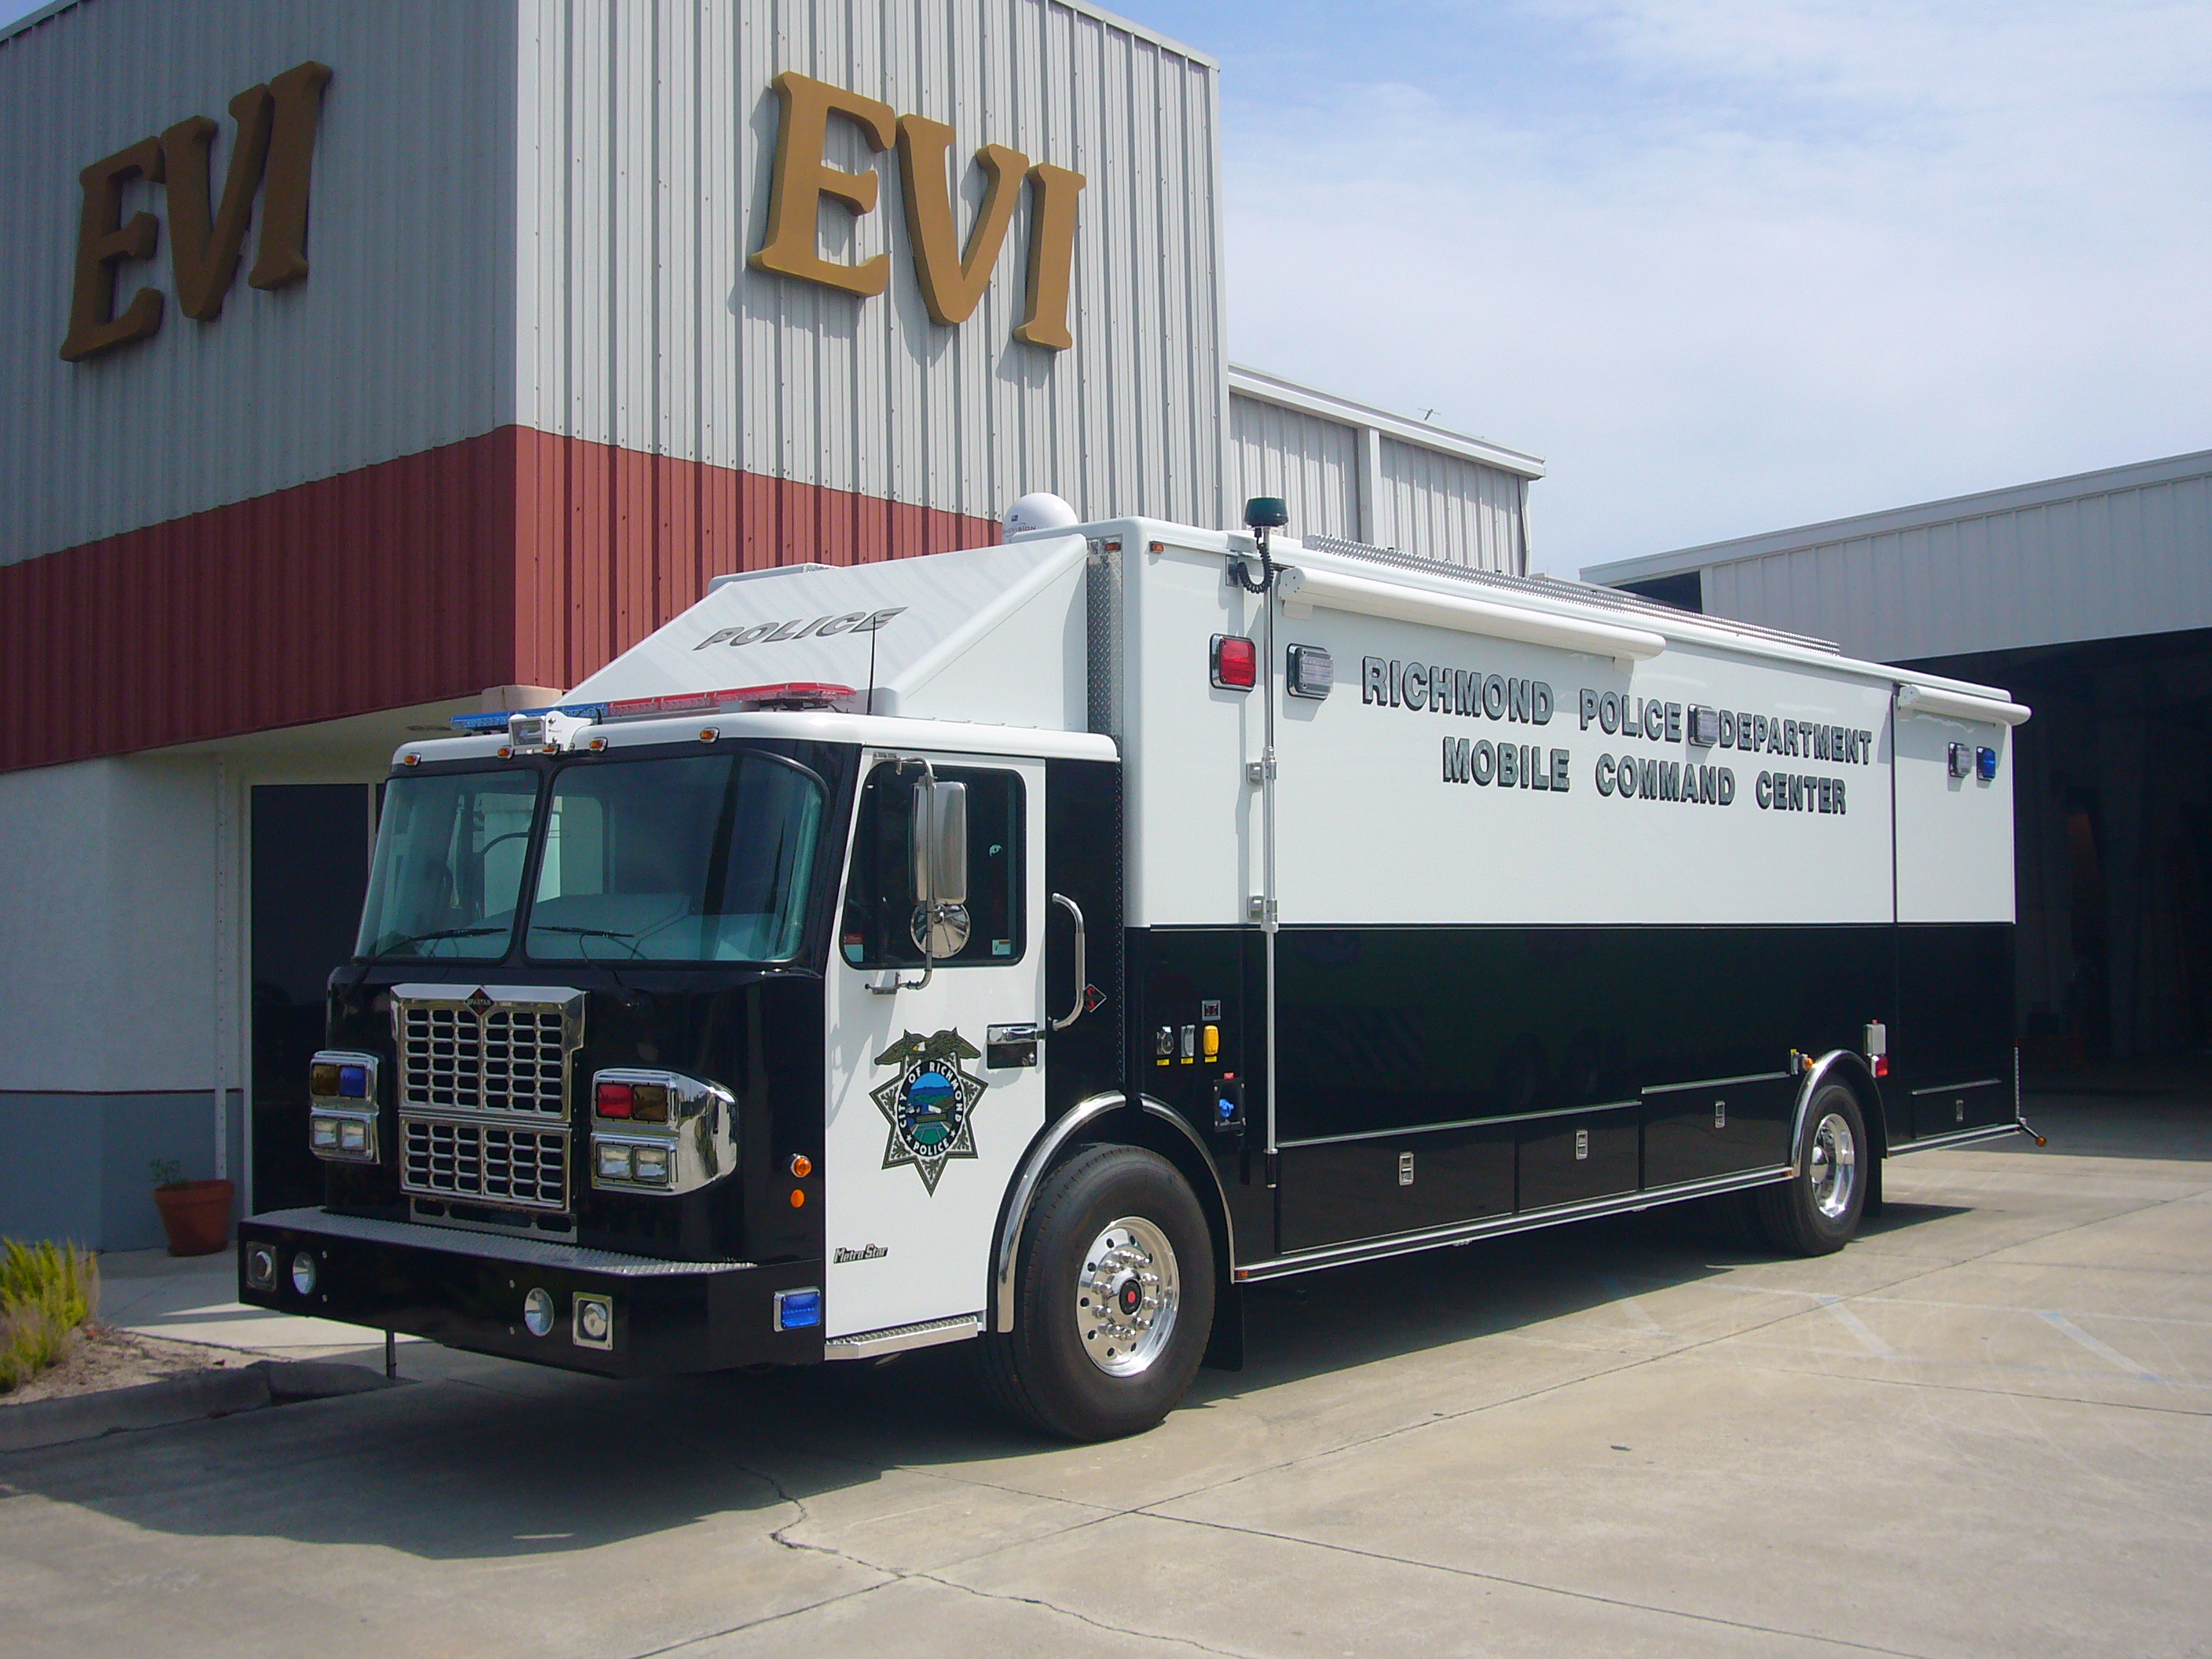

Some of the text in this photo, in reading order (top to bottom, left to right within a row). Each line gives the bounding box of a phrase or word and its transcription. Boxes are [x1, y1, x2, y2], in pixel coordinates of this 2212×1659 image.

[59, 60, 333, 363] EVI
[749, 71, 1086, 352] EVI
[692, 606, 909, 651] POLICE
[1362, 656, 1873, 765] RICHMOND POLICE DEPARTMENT
[1442, 736, 1847, 815] MOBILE COMMAND CENTER
[899, 1062, 963, 1128] CITY OF RICHMOND
[913, 1138, 949, 1155] POLICE
